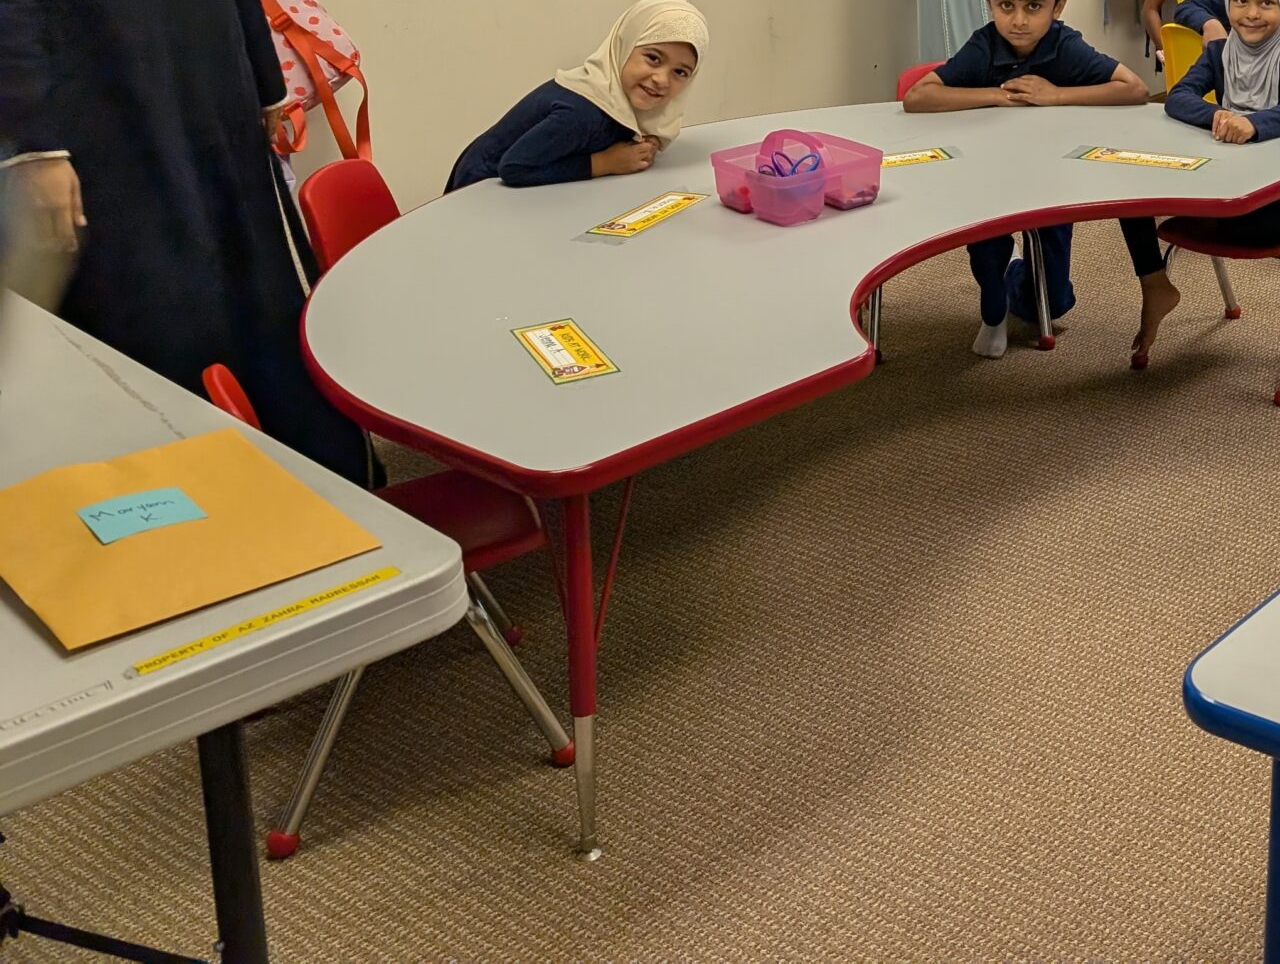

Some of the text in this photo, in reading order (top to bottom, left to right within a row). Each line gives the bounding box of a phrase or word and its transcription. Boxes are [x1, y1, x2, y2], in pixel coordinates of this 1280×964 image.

[133, 642, 204, 671] PROPERTY
[212, 633, 229, 642] OF
[238, 622, 255, 633] AZ
[262, 604, 305, 623] ZAHRA
